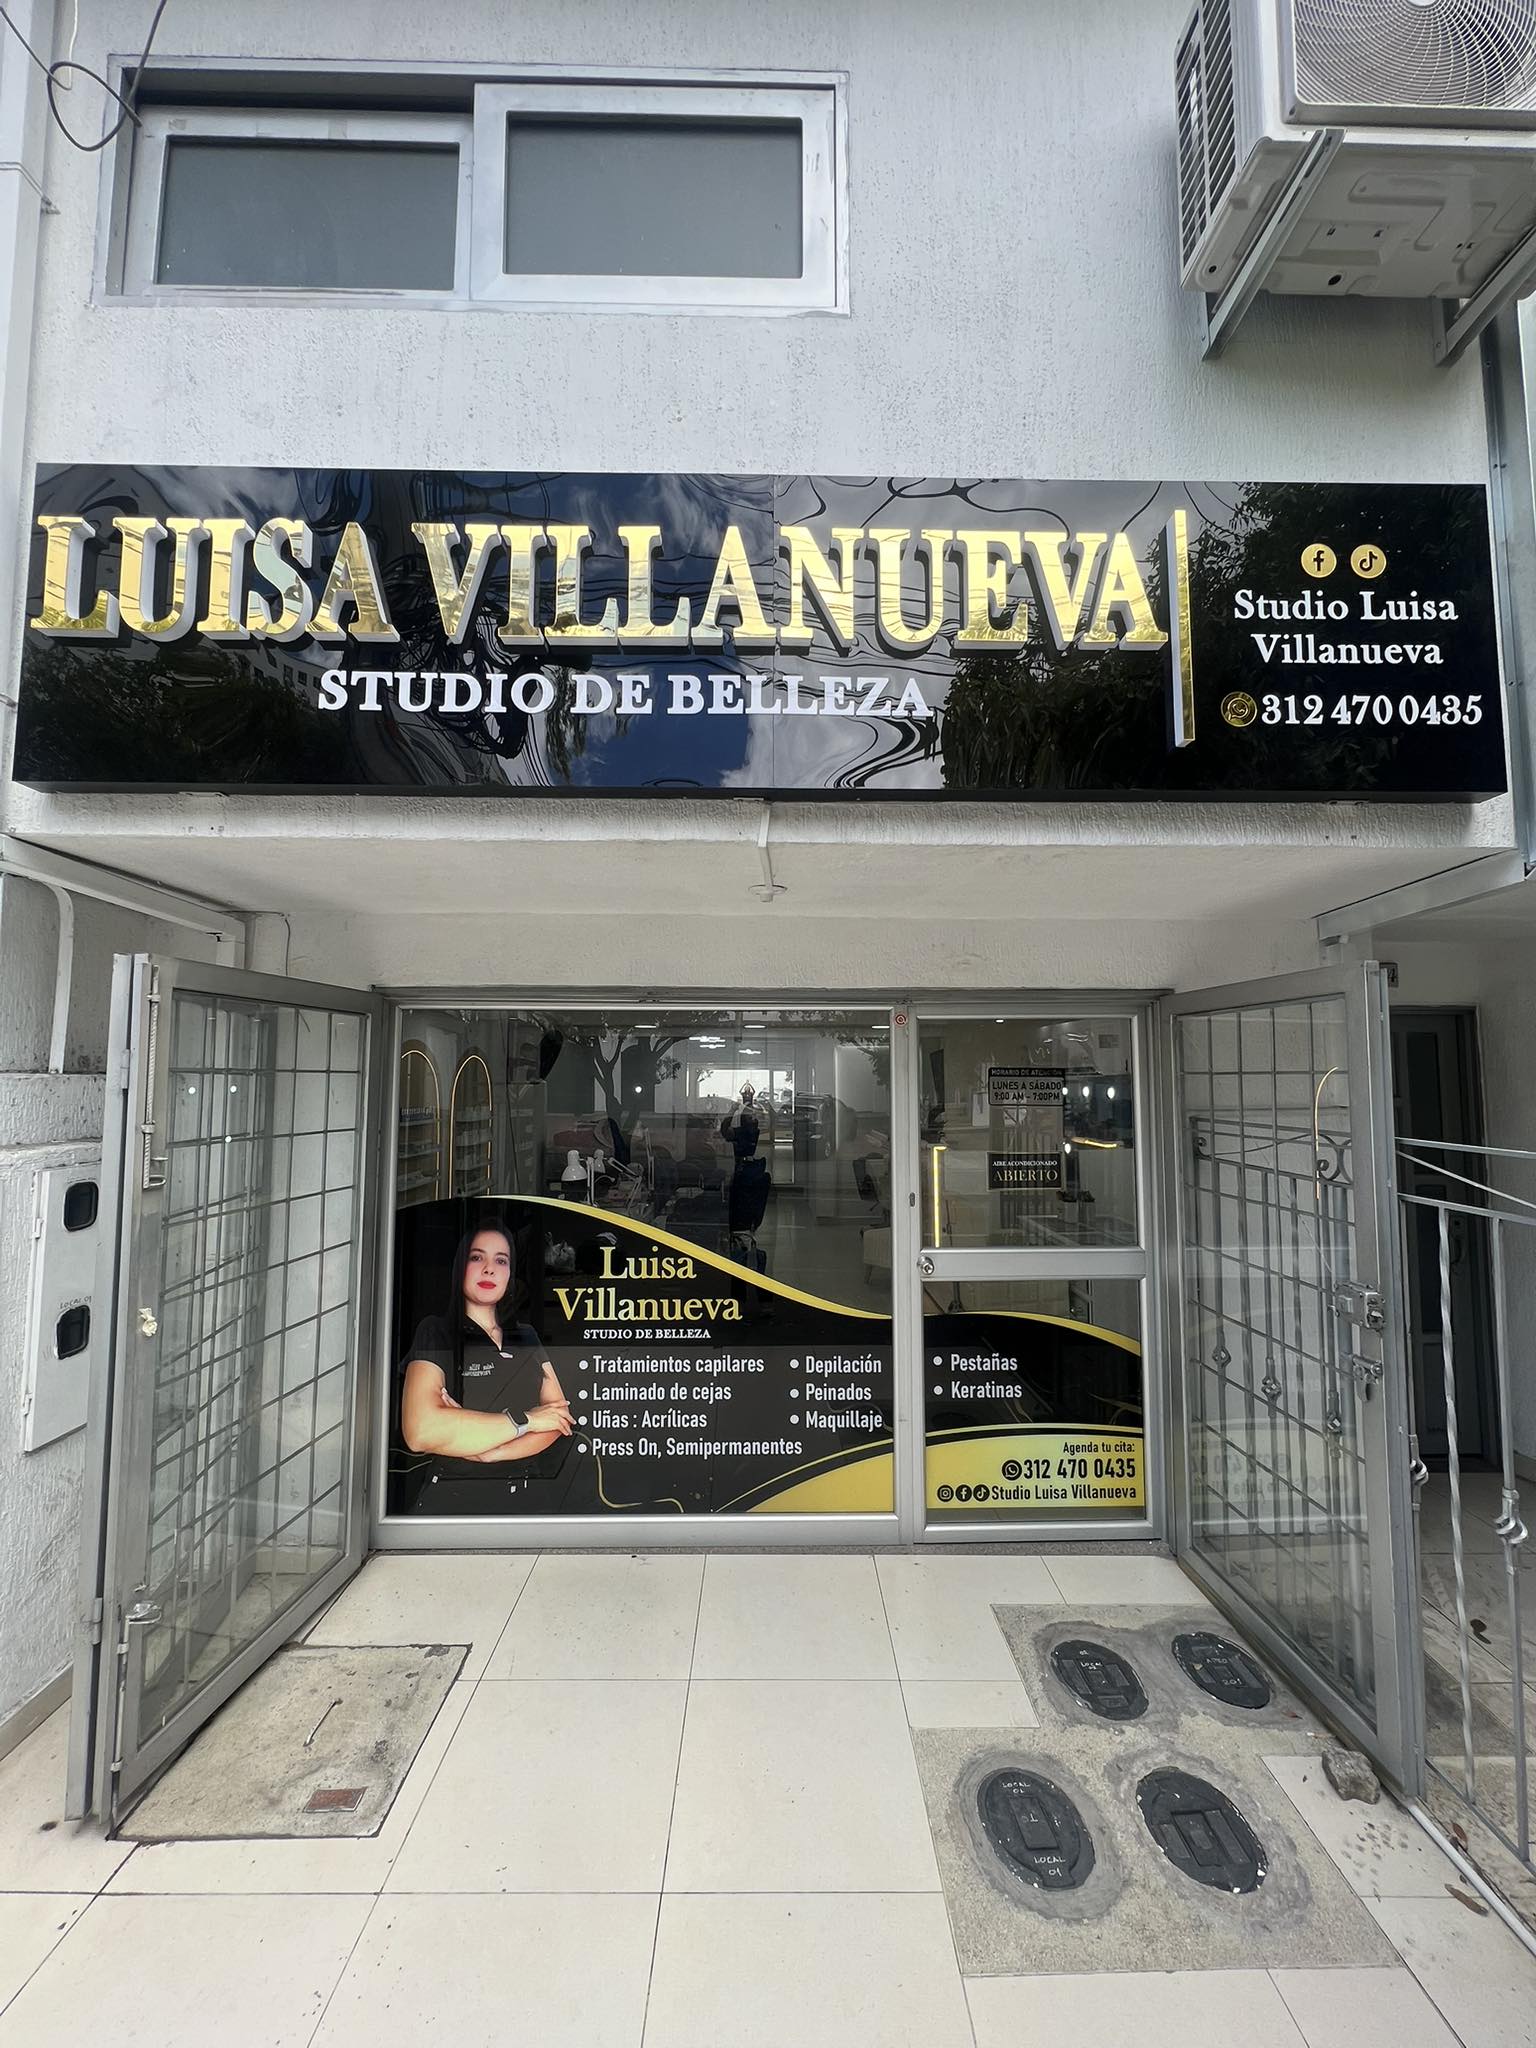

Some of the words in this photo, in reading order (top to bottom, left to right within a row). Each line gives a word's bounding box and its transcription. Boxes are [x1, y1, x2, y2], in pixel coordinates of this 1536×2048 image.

[30, 514, 400, 643] LUISA
[412, 520, 1169, 651] VILLANUEVA
[1233, 588, 1349, 622] Studio
[1360, 591, 1459, 622] Luisa
[1250, 634, 1445, 666] Villanueva
[317, 669, 555, 715] STUDIO
[572, 673, 654, 714] DE
[667, 674, 934, 719] BELLEZA
[1261, 694, 1325, 726] 312
[1330, 695, 1393, 726] 470
[1399, 695, 1483, 726] 0435
[1029, 1080, 1061, 1089] SÁBADO
[994, 1092, 1009, 1100] 9:00
[994, 1169, 1058, 1182] ABIERTO
[599, 1246, 697, 1280] Luisa
[553, 1287, 742, 1322] Villanueva
[583, 1328, 633, 1340] STUDIO
[635, 1329, 653, 1339] DE
[655, 1328, 712, 1339] BELLEZA
[593, 1355, 691, 1373] Tratamientos
[695, 1355, 764, 1378] capilares
[805, 1354, 882, 1377] Depilación
[950, 1353, 1018, 1372] Pestañas
[592, 1382, 666, 1402] Laminado
[669, 1382, 688, 1402] de
[691, 1382, 732, 1406] cejas
[805, 1382, 872, 1402] Peinados
[951, 1381, 1023, 1398] Keratinas
[592, 1410, 629, 1429] Uñas
[641, 1409, 707, 1429] Acrílicas
[805, 1410, 884, 1434] Maquillaje
[592, 1438, 634, 1457] Press
[638, 1438, 662, 1460] On,
[666, 1438, 803, 1461] Semipermanentes
[1063, 1441, 1099, 1456] Agenda
[1101, 1442, 1111, 1452] tu
[1114, 1442, 1135, 1453] cita:
[1024, 1459, 1051, 1479] 312
[1057, 1459, 1088, 1478] 470
[1094, 1458, 1136, 1478] 0435
[992, 1485, 1031, 1500] Studio
[1035, 1486, 1068, 1500] Luisa
[1071, 1486, 1136, 1499] Villanueva
[1033, 1856, 1066, 1864] LOCAL
